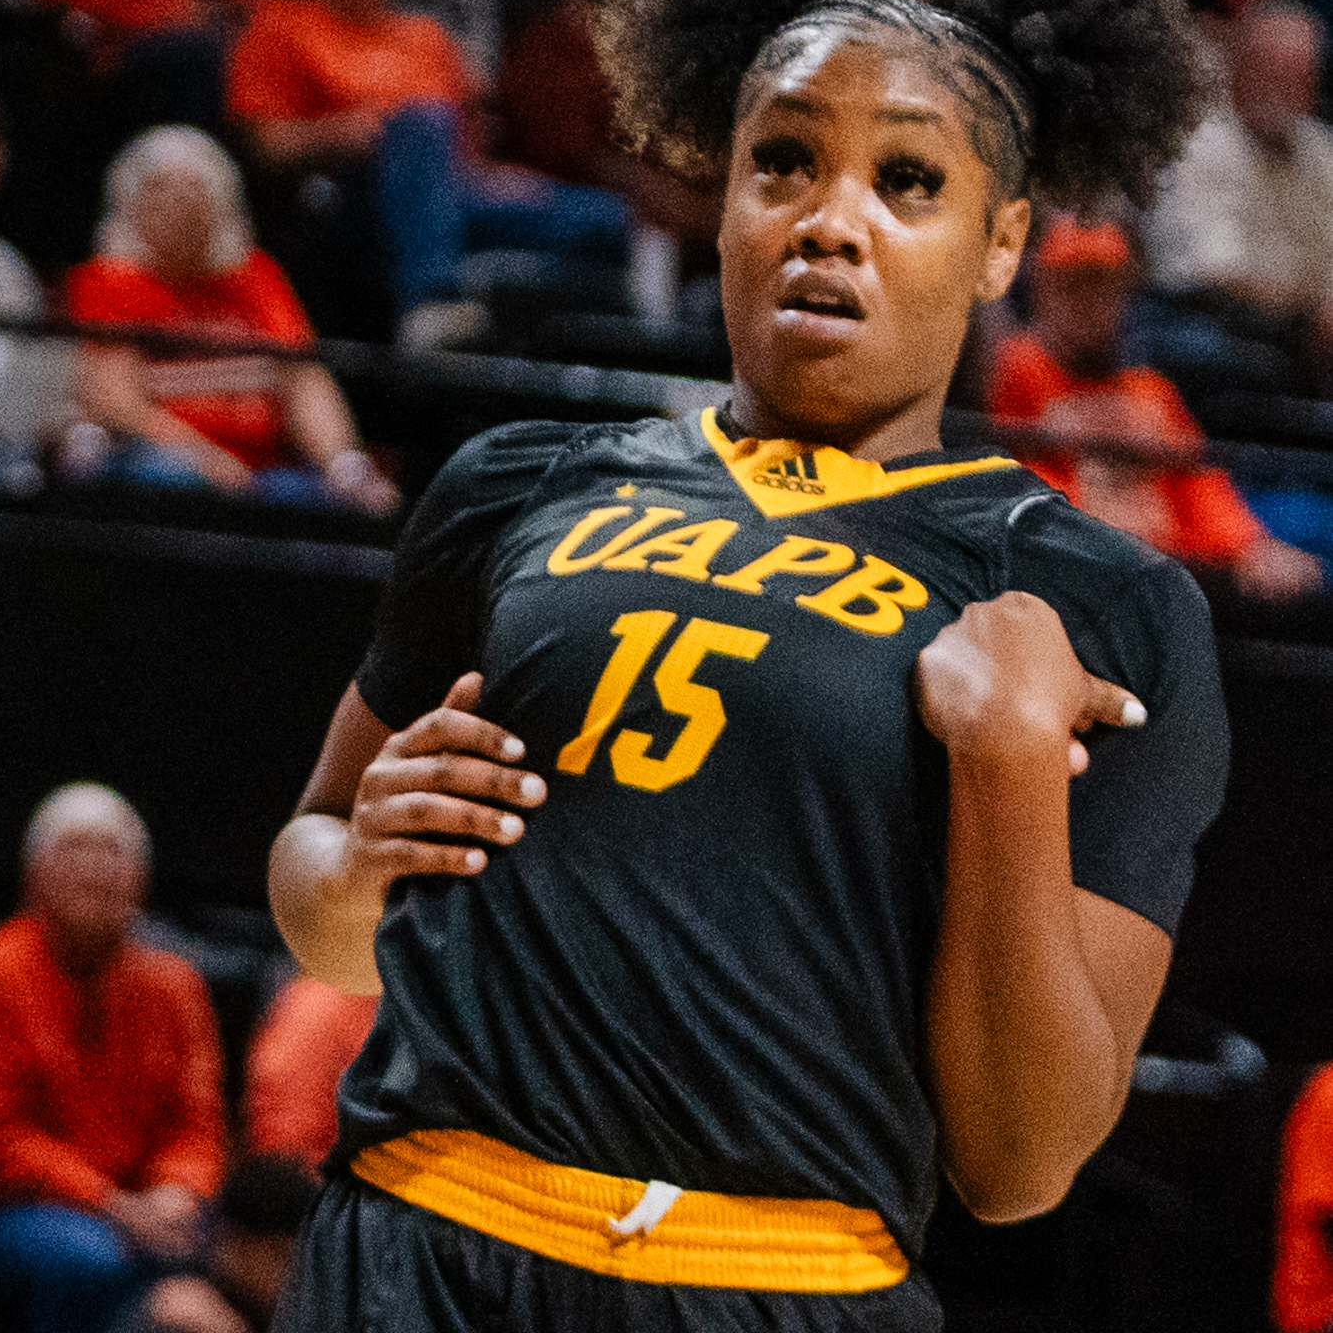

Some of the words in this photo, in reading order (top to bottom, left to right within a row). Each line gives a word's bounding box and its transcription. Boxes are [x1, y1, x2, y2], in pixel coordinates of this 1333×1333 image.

[753, 475, 826, 496] adidas
[547, 506, 929, 635] UAPB
[557, 609, 770, 793] 15
